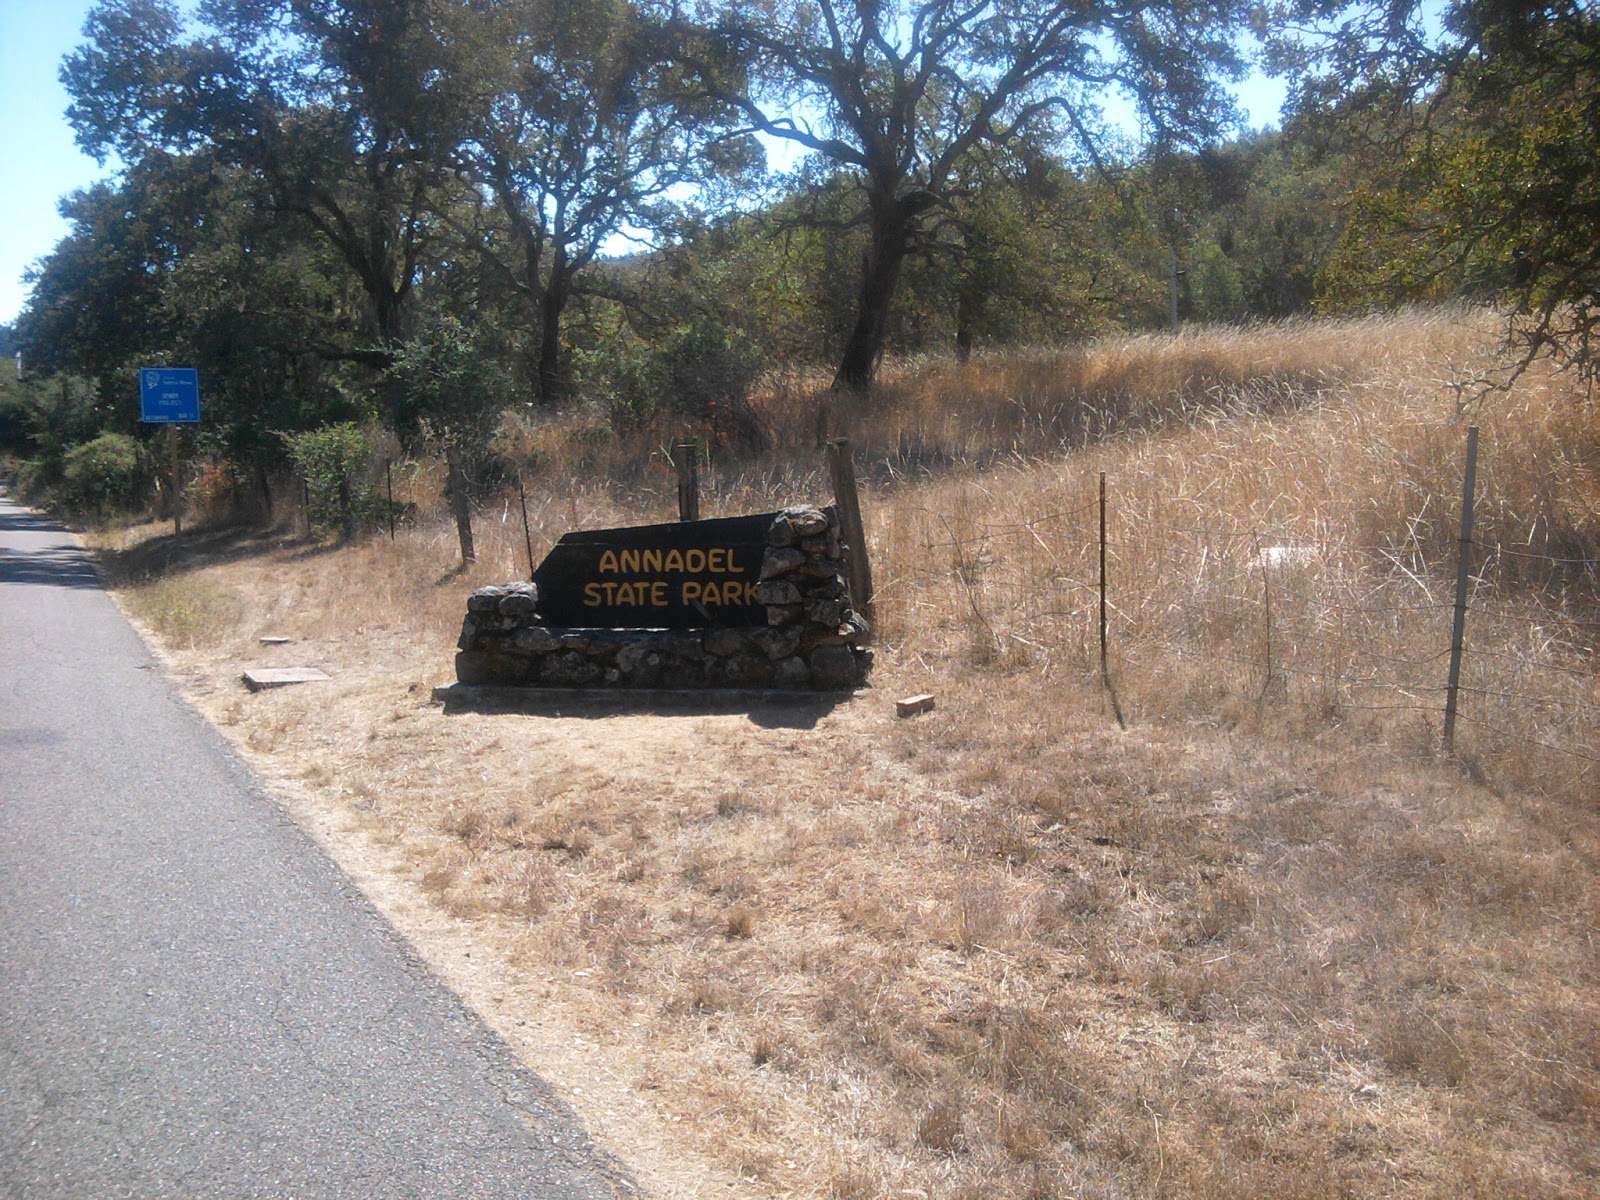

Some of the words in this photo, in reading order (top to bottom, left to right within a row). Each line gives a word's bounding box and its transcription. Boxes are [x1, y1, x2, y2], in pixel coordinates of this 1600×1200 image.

[599, 548, 745, 574] ANNADEL
[583, 581, 669, 607] STATE
[682, 581, 759, 607] PARK
